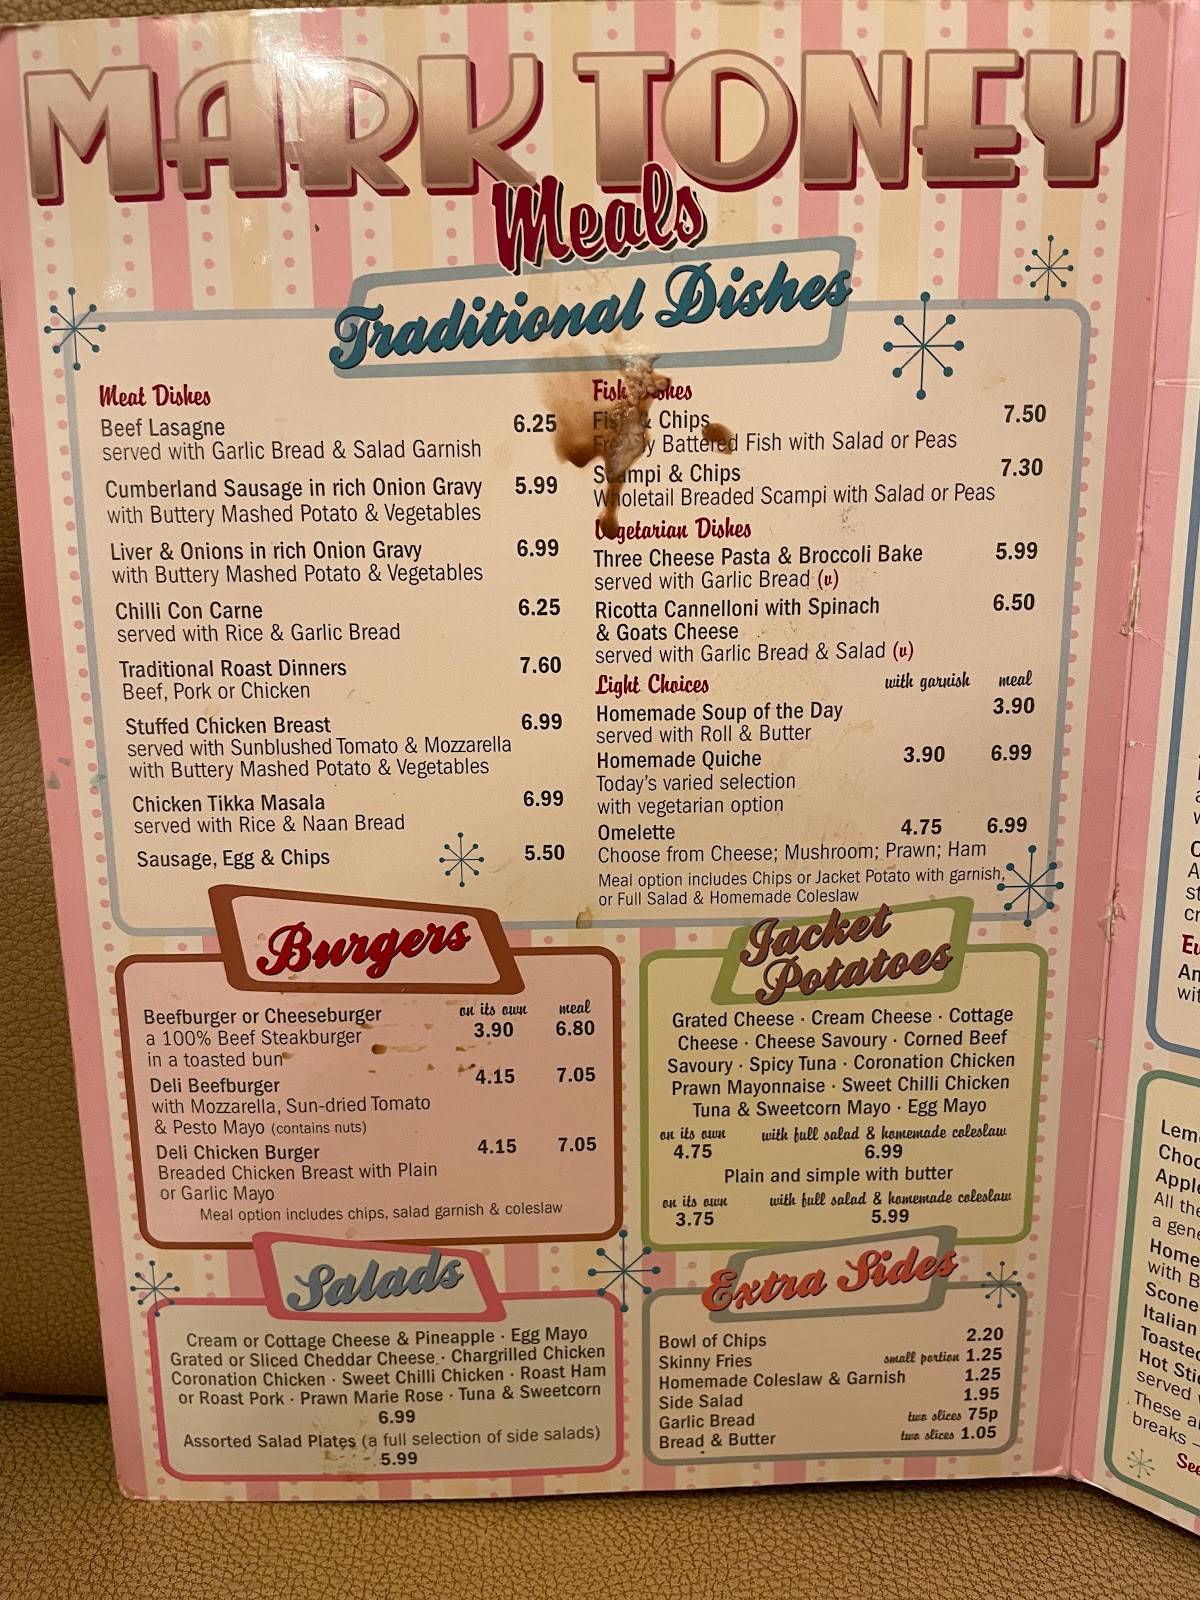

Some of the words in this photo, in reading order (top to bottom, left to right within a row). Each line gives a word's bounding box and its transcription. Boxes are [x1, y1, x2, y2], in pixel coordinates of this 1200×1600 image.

[24, 53, 543, 205] MARK
[573, 50, 1125, 193] TONEY
[492, 162, 708, 275] Meals
[329, 277, 646, 368] Traditional
[655, 261, 853, 328] Dishes
[100, 385, 147, 407] Meat
[152, 384, 211, 406] Dishes
[1004, 404, 1046, 423] 7.50
[101, 418, 142, 437] Beef
[149, 418, 225, 440] Lasagne
[514, 414, 556, 432] 6.25
[1001, 458, 1043, 476] 7.30
[106, 480, 216, 498] Cumberland
[224, 479, 302, 501] Sausage
[310, 478, 325, 496] in
[333, 478, 365, 496] rich
[373, 478, 425, 496] Onion
[433, 477, 482, 499] Gravy
[515, 476, 557, 494] 5.99
[593, 550, 642, 567] Three
[650, 549, 714, 566] Cheese
[722, 548, 769, 565] Pasta
[778, 547, 791, 564] &
[800, 545, 871, 564] Broccoli
[879, 544, 922, 562] Bake
[996, 542, 1037, 560] 5.99
[116, 602, 160, 620] Chilli
[168, 602, 202, 619] Con
[210, 601, 262, 619] Carne
[519, 598, 560, 616] 6.25
[119, 660, 213, 677] Traditional
[221, 660, 272, 676] Roast
[279, 659, 346, 676] Dinners
[520, 656, 561, 673] 7.60
[595, 674, 640, 699] Light
[648, 674, 709, 694] Choices
[885, 672, 914, 689] with
[920, 671, 970, 692] garnish
[999, 670, 1032, 687] meal
[123, 683, 167, 702] Beef,
[174, 682, 211, 699] Pork
[218, 686, 235, 699] or
[242, 682, 310, 698] Chicken
[597, 704, 695, 722] Homemade
[703, 704, 746, 723] Soup
[754, 702, 771, 719] of
[776, 702, 803, 719] the
[811, 702, 842, 721] Day
[993, 697, 1034, 714] 3.90
[133, 796, 202, 812] Chicken
[207, 795, 254, 811] Tikka
[261, 794, 325, 810] Masala
[524, 790, 563, 806] 6.99
[598, 824, 675, 840] Omelette
[901, 819, 942, 835] 4.75
[987, 817, 1027, 833] 6.99
[138, 851, 216, 870] Sausage,
[223, 850, 255, 869] Egg
[261, 849, 275, 865] &
[281, 849, 330, 868] Chips
[525, 845, 564, 861] 5.50
[599, 873, 632, 887] Meal
[638, 873, 682, 889] option
[689, 872, 747, 885] includes
[753, 871, 792, 887] Chips
[797, 874, 811, 884] or
[815, 870, 860, 883] Jacket
[866, 869, 910, 882] Potato
[916, 868, 943, 882] with
[950, 867, 1004, 884] garnish,
[740, 903, 892, 966] Jacket
[256, 919, 471, 979] Burgers
[755, 943, 953, 1005] Potatoes
[460, 1007, 475, 1016] on
[481, 1003, 495, 1016] its
[502, 1006, 528, 1015] own
[559, 999, 591, 1014] meal
[144, 1009, 236, 1028] Beefburger
[243, 1012, 259, 1023] or
[265, 1007, 382, 1029] Cheeseburger
[474, 1022, 513, 1038] 3.90
[556, 1020, 594, 1036] 6.80
[762, 1127, 788, 1141] with
[794, 1127, 819, 1143] full
[823, 1126, 859, 1141] salad
[882, 1125, 947, 1139] homemade
[952, 1123, 1007, 1138] coleslaw
[674, 1144, 712, 1159] 4.75
[865, 1144, 902, 1159] 6.99
[725, 1169, 763, 1183] Plain
[771, 1168, 800, 1182] and
[806, 1167, 860, 1185] simple
[866, 1167, 898, 1181] with
[905, 1166, 953, 1180] butter
[1154, 1192, 1174, 1209] All
[201, 1208, 232, 1220] Meal
[239, 1208, 280, 1223] option
[287, 1208, 343, 1220] includes
[348, 1207, 388, 1221] chips,
[393, 1205, 429, 1218] salad
[435, 1204, 483, 1219] garnish
[490, 1203, 499, 1215] &
[506, 1202, 562, 1214] coleslaw
[1152, 1216, 1161, 1228] a
[286, 1248, 464, 1311] Salads
[701, 1268, 827, 1311] Extra
[836, 1246, 958, 1292] Sides
[1148, 1261, 1181, 1283] with
[1143, 1304, 1197, 1336] Italian
[660, 1334, 695, 1348] Bowl
[703, 1334, 718, 1347] of
[723, 1333, 766, 1350] Chips
[967, 1327, 1003, 1341] 2.20
[659, 1355, 710, 1371] Skinny
[716, 1354, 752, 1367] Fries
[884, 1351, 916, 1363] small
[921, 1352, 959, 1365] portion
[966, 1347, 1002, 1362] 1.25
[1139, 1349, 1168, 1372] Hot
[660, 1374, 747, 1389] Homemade
[754, 1373, 822, 1387] Coleslaw
[829, 1372, 840, 1385] &
[847, 1370, 905, 1385] Garnish
[965, 1367, 1000, 1381] 1.25
[1137, 1371, 1192, 1400] served
[908, 1412, 927, 1422] two
[932, 1410, 961, 1421] slices
[969, 1407, 998, 1422] 75p
[1134, 1390, 1181, 1421] These
[379, 1410, 415, 1424] 6.99
[901, 1431, 920, 1440] two
[925, 1429, 954, 1440] slices
[961, 1426, 996, 1439] 1.05
[1132, 1411, 1187, 1445] breaks
[184, 1434, 251, 1448] Assorted
[258, 1435, 302, 1447] Salad
[309, 1435, 356, 1450] Plates
[362, 1435, 377, 1449] (a
[384, 1433, 406, 1446] full
[412, 1431, 480, 1445] selection
[487, 1430, 502, 1443] of
[507, 1429, 538, 1443] side
[544, 1426, 600, 1440] salads)
[660, 1434, 704, 1449] Bread
[711, 1433, 722, 1446] &
[729, 1433, 776, 1446] Butter
[381, 1452, 417, 1465] 5.99
